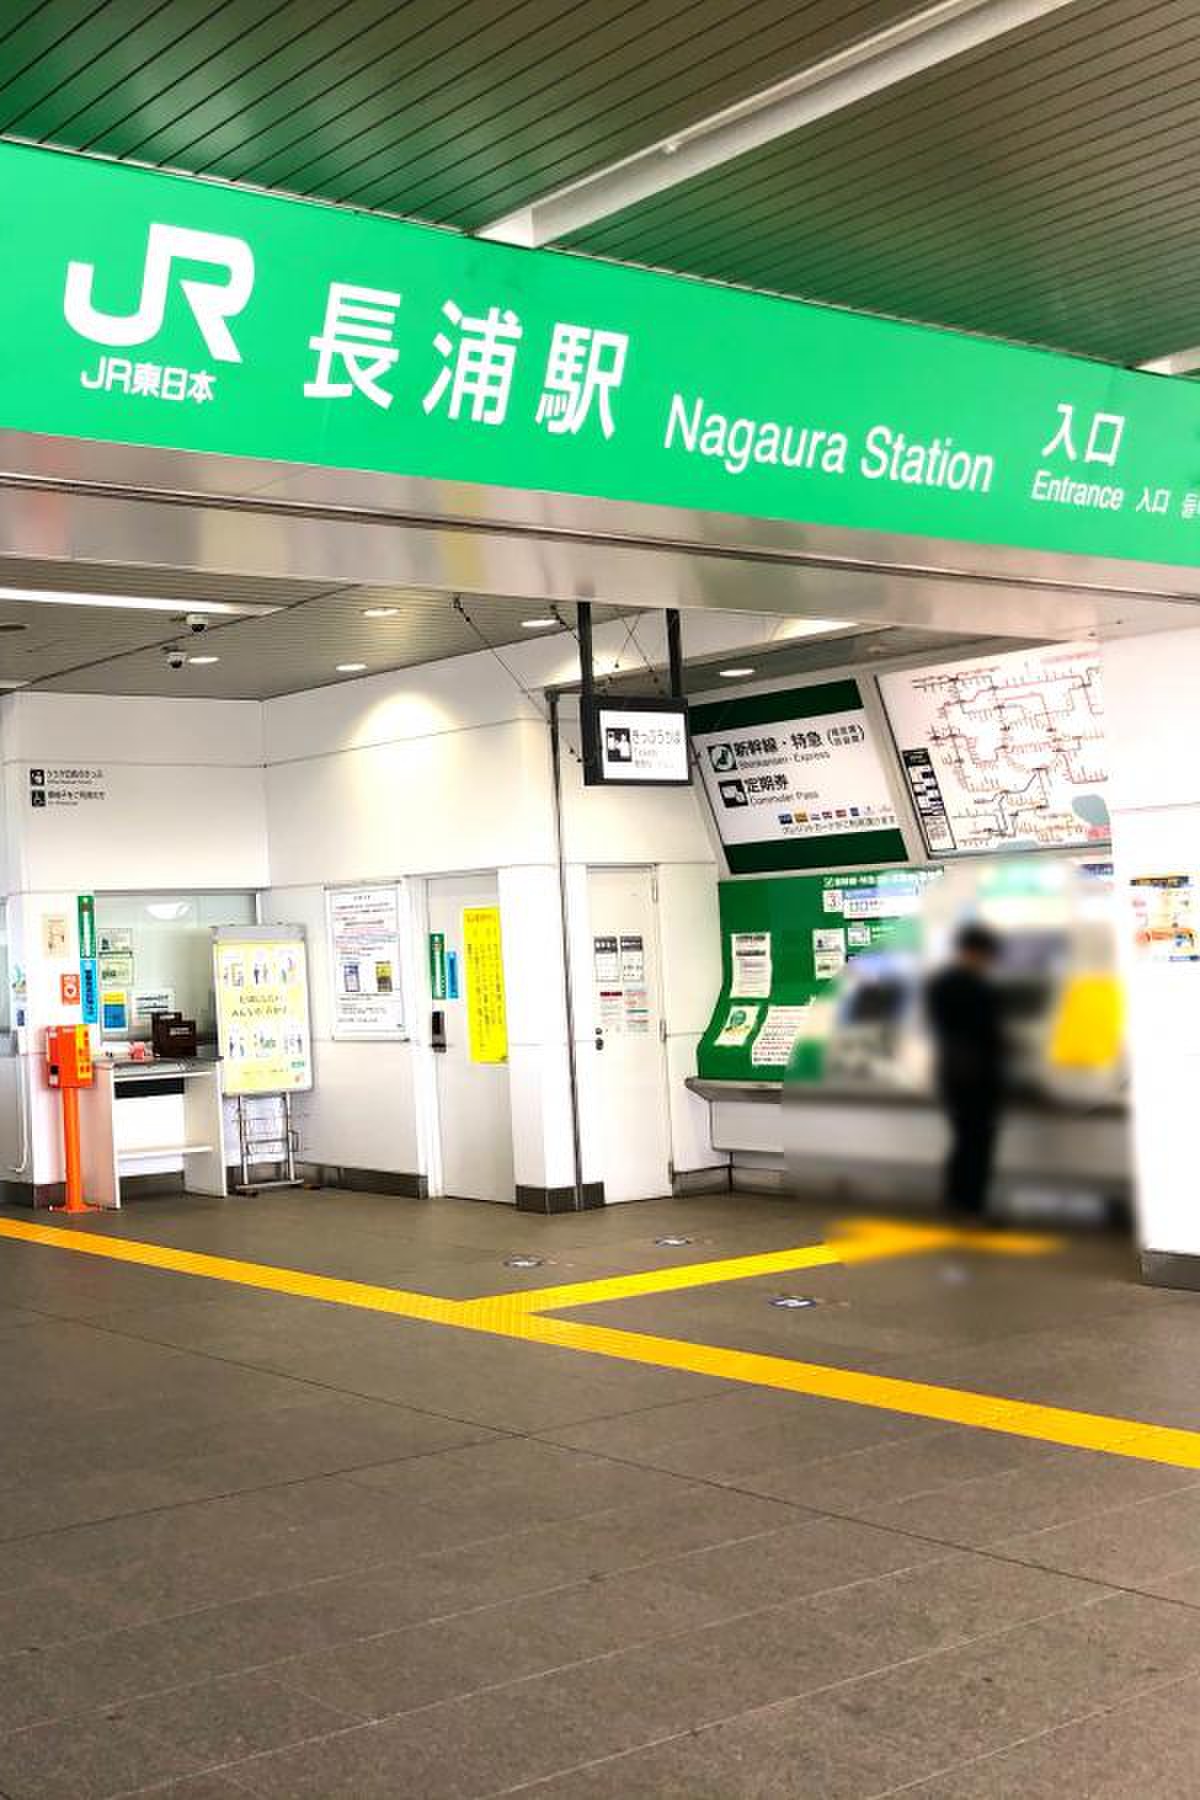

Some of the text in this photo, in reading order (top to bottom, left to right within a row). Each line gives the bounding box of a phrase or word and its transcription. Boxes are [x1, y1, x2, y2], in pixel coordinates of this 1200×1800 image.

[63, 223, 255, 364] JR
[80, 356, 216, 404] JR東日本
[303, 281, 629, 440] 長浦駅
[663, 393, 995, 494] Nagaura Station
[1041, 403, 1125, 467] 入口
[1031, 470, 1124, 511] Entrance
[1136, 486, 1170, 514] 入口
[744, 774, 789, 793] 定期券
